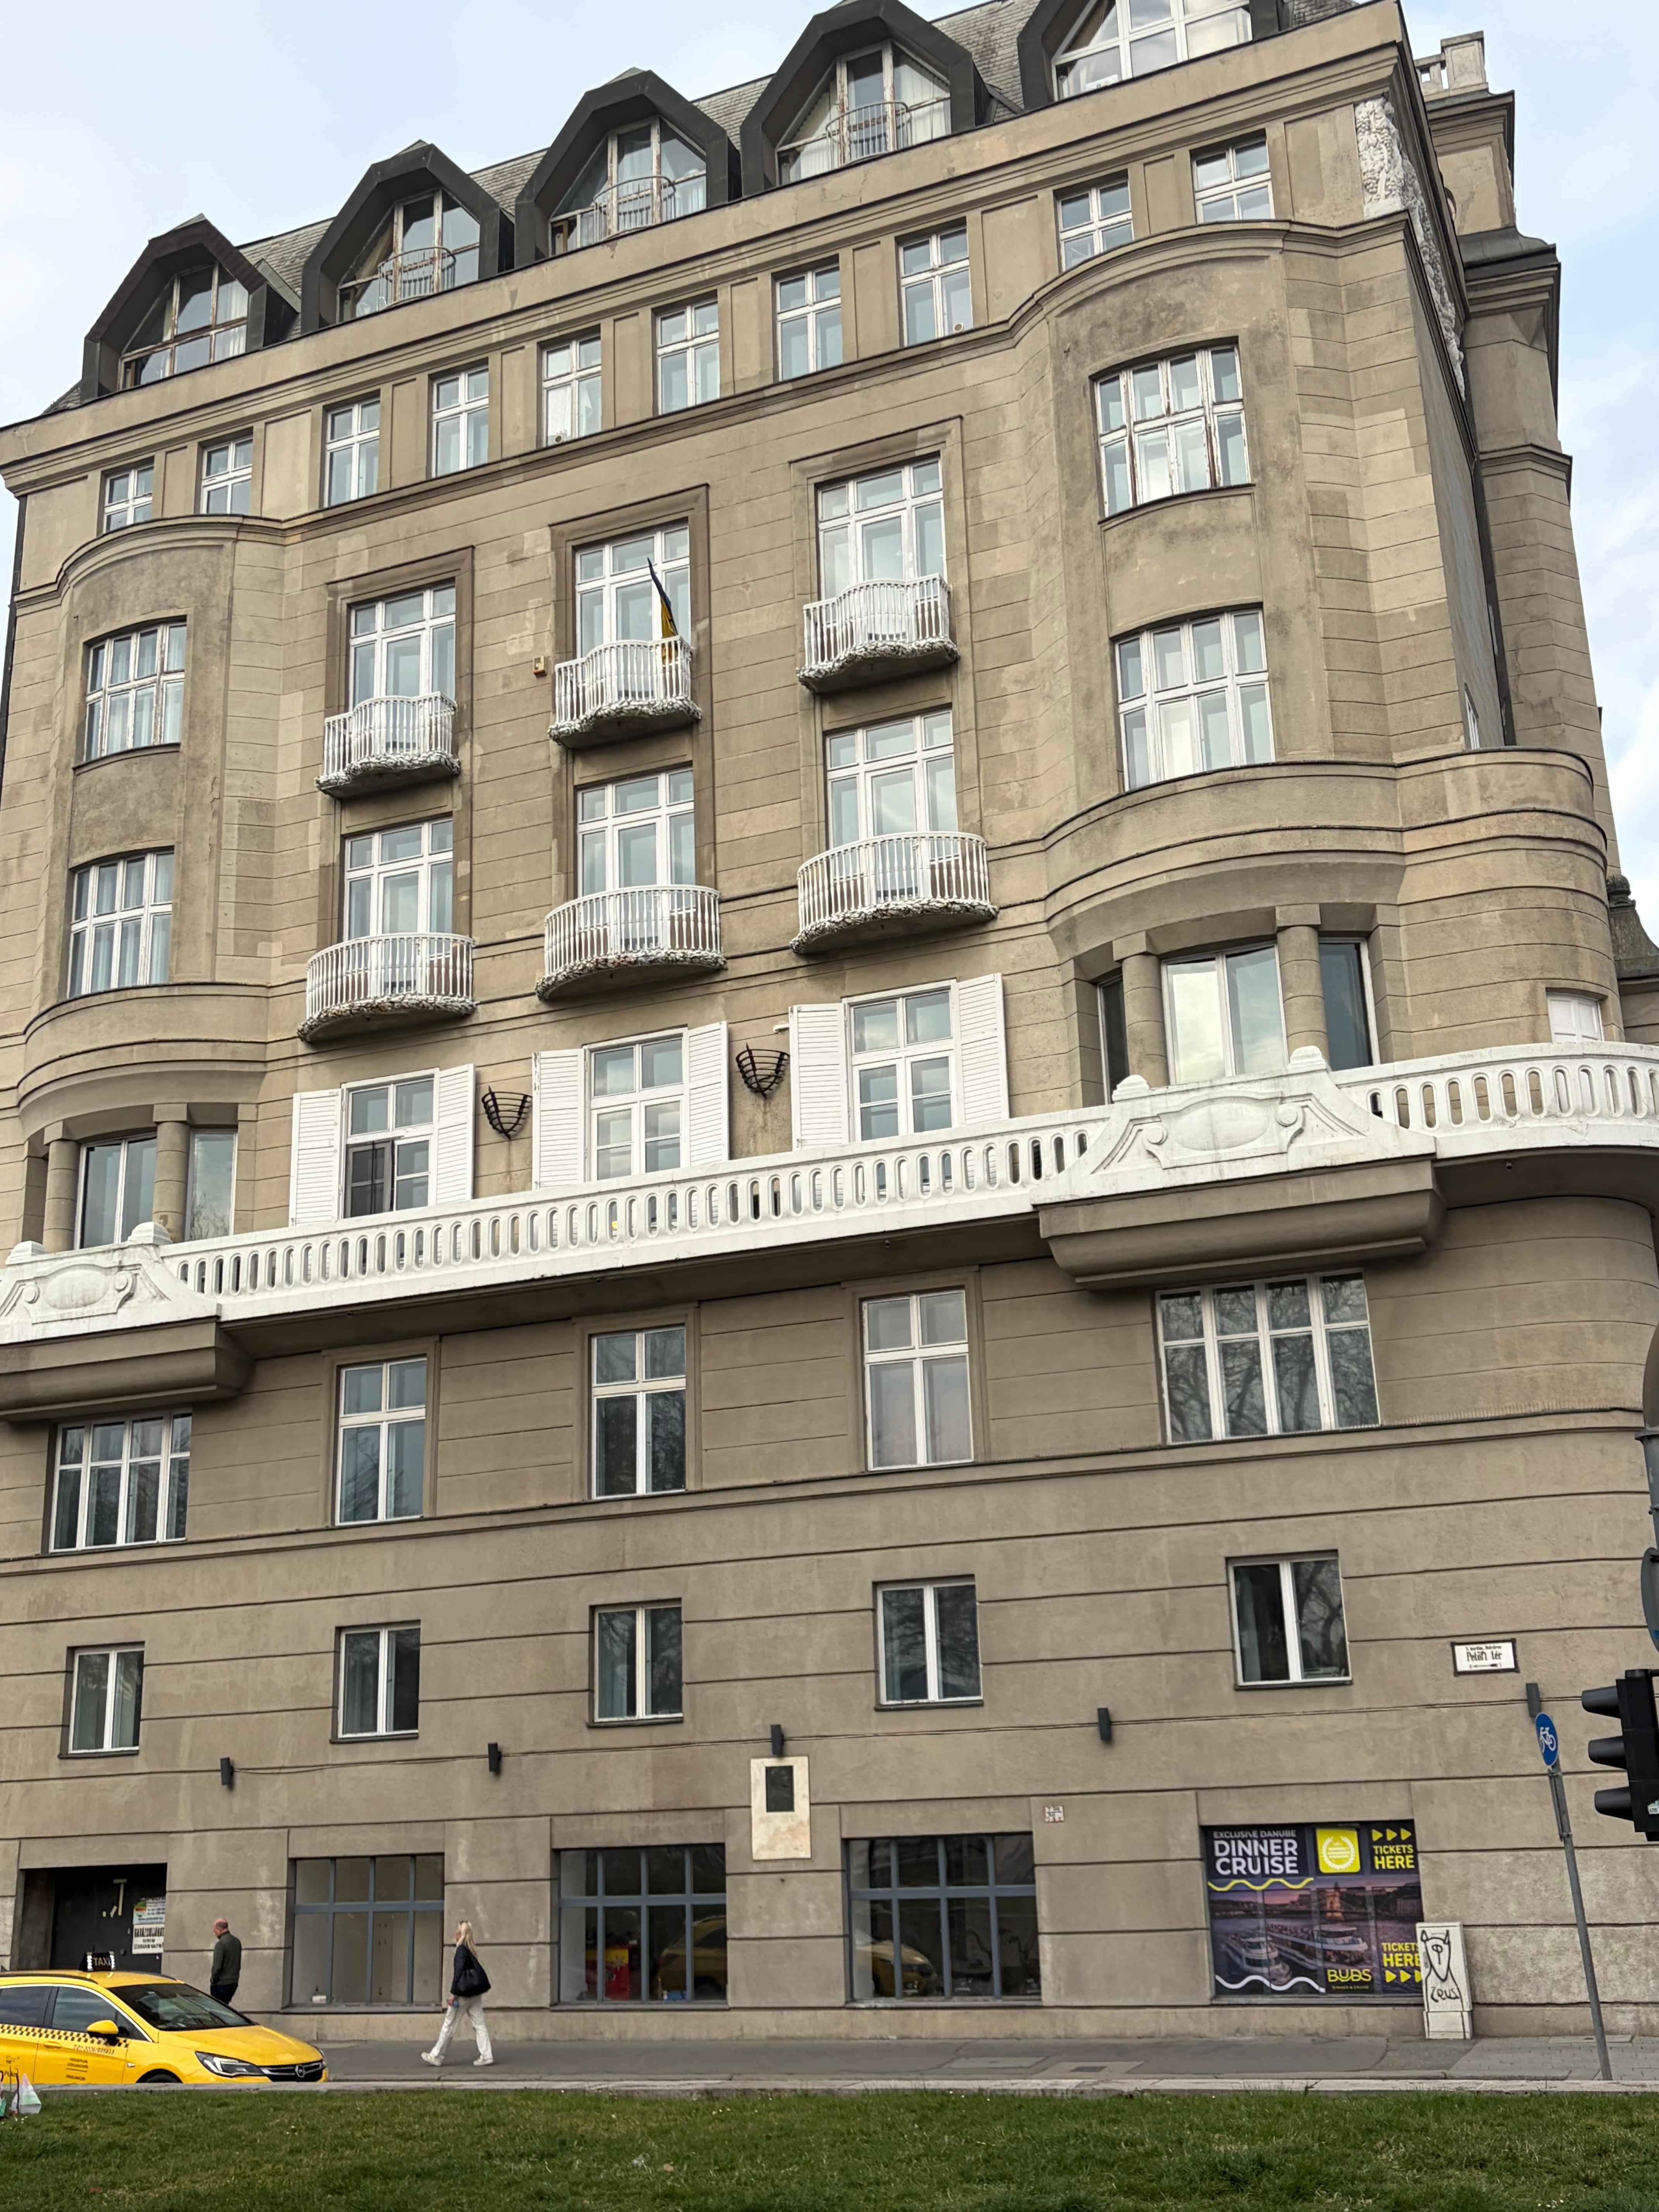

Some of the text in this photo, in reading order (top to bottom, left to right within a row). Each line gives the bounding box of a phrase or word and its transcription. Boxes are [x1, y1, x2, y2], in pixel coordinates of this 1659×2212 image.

[1260, 1829, 1297, 1838] DANUBE
[1214, 1839, 1298, 1857] DINNER
[1372, 1844, 1414, 1855] TICKETS
[1215, 1856, 1299, 1875] CRUISE
[1374, 1855, 1415, 1870] HERE
[93, 1957, 111, 1967] TAXI
[1327, 1968, 1372, 1982] BUDS
